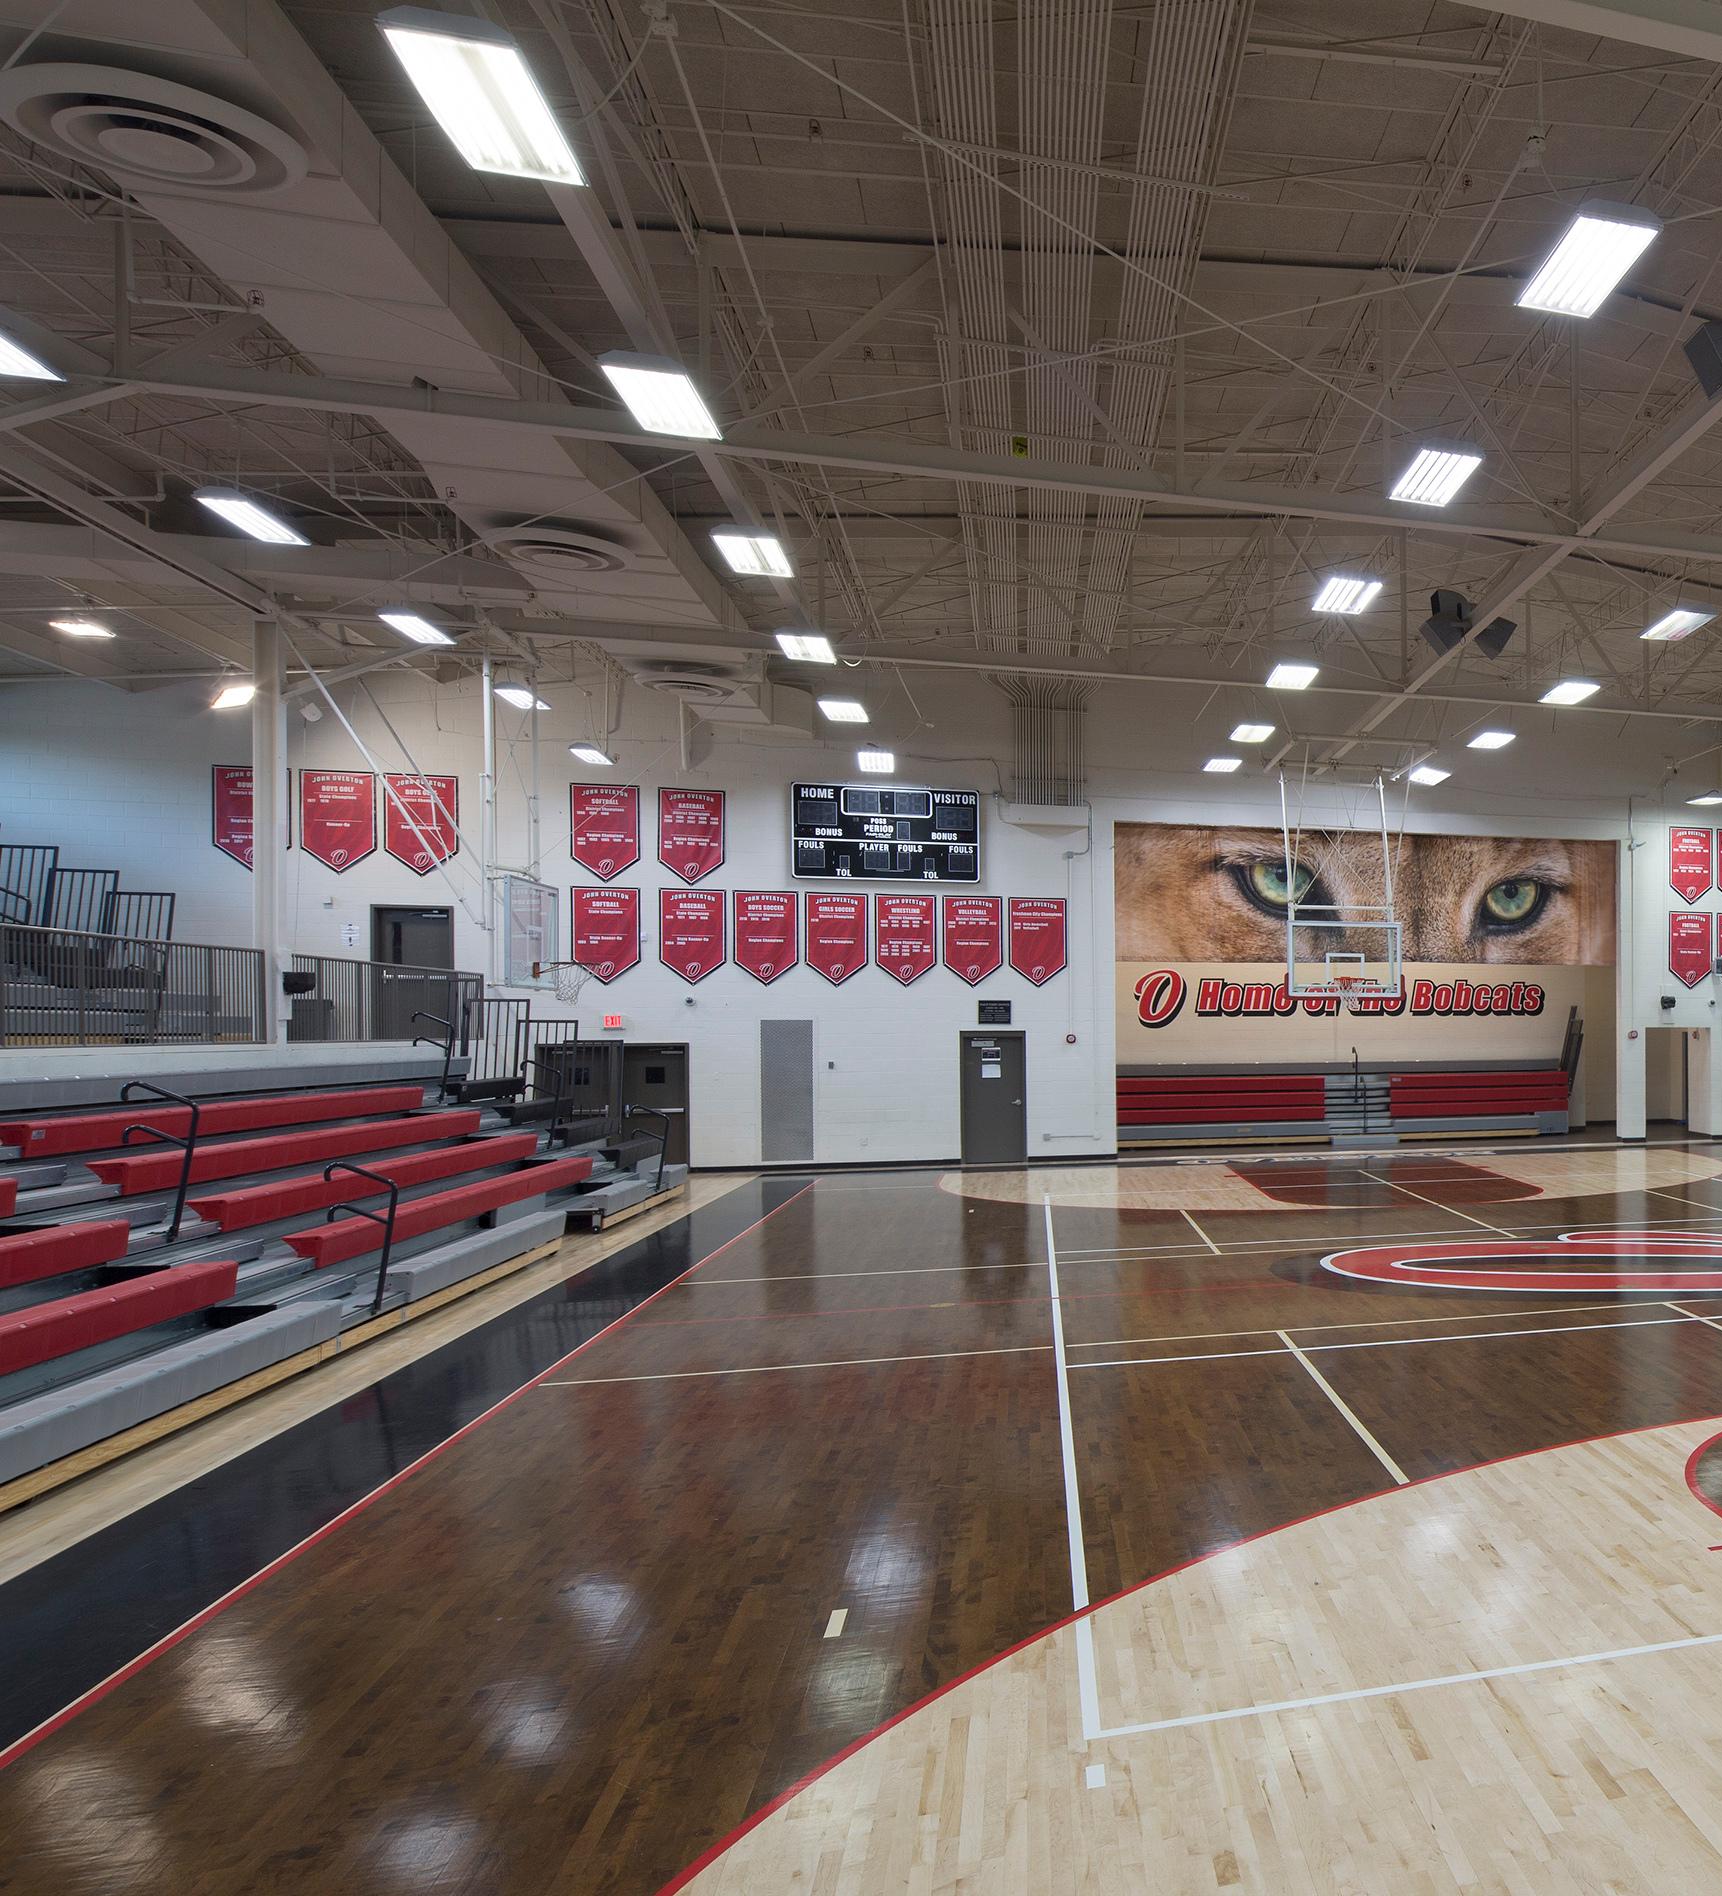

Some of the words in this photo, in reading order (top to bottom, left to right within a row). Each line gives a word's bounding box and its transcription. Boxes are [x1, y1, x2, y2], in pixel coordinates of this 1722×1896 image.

[312, 775, 330, 783] JOHN
[333, 775, 364, 785] OVERTON
[600, 789, 628, 797] OVERTON
[801, 788, 834, 798] HOME
[687, 793, 714, 802] OVERTON
[934, 794, 976, 805] VISITOR
[815, 828, 843, 836] BONUS
[864, 824, 893, 833] PERIOD
[931, 832, 957, 840] BONUS
[799, 841, 824, 849] FOULS
[859, 843, 889, 852] PLAYER
[949, 846, 974, 854] FOULS
[923, 871, 938, 879] TOL
[601, 892, 629, 900] OVERTON
[688, 893, 715, 902] OVERTON
[761, 895, 787, 903] OVERTON
[832, 897, 858, 905] OVERTON
[968, 900, 992, 908] OVERTON
[1410, 979, 1546, 1016] Bobcats
[605, 1015, 621, 1026] EXIT
